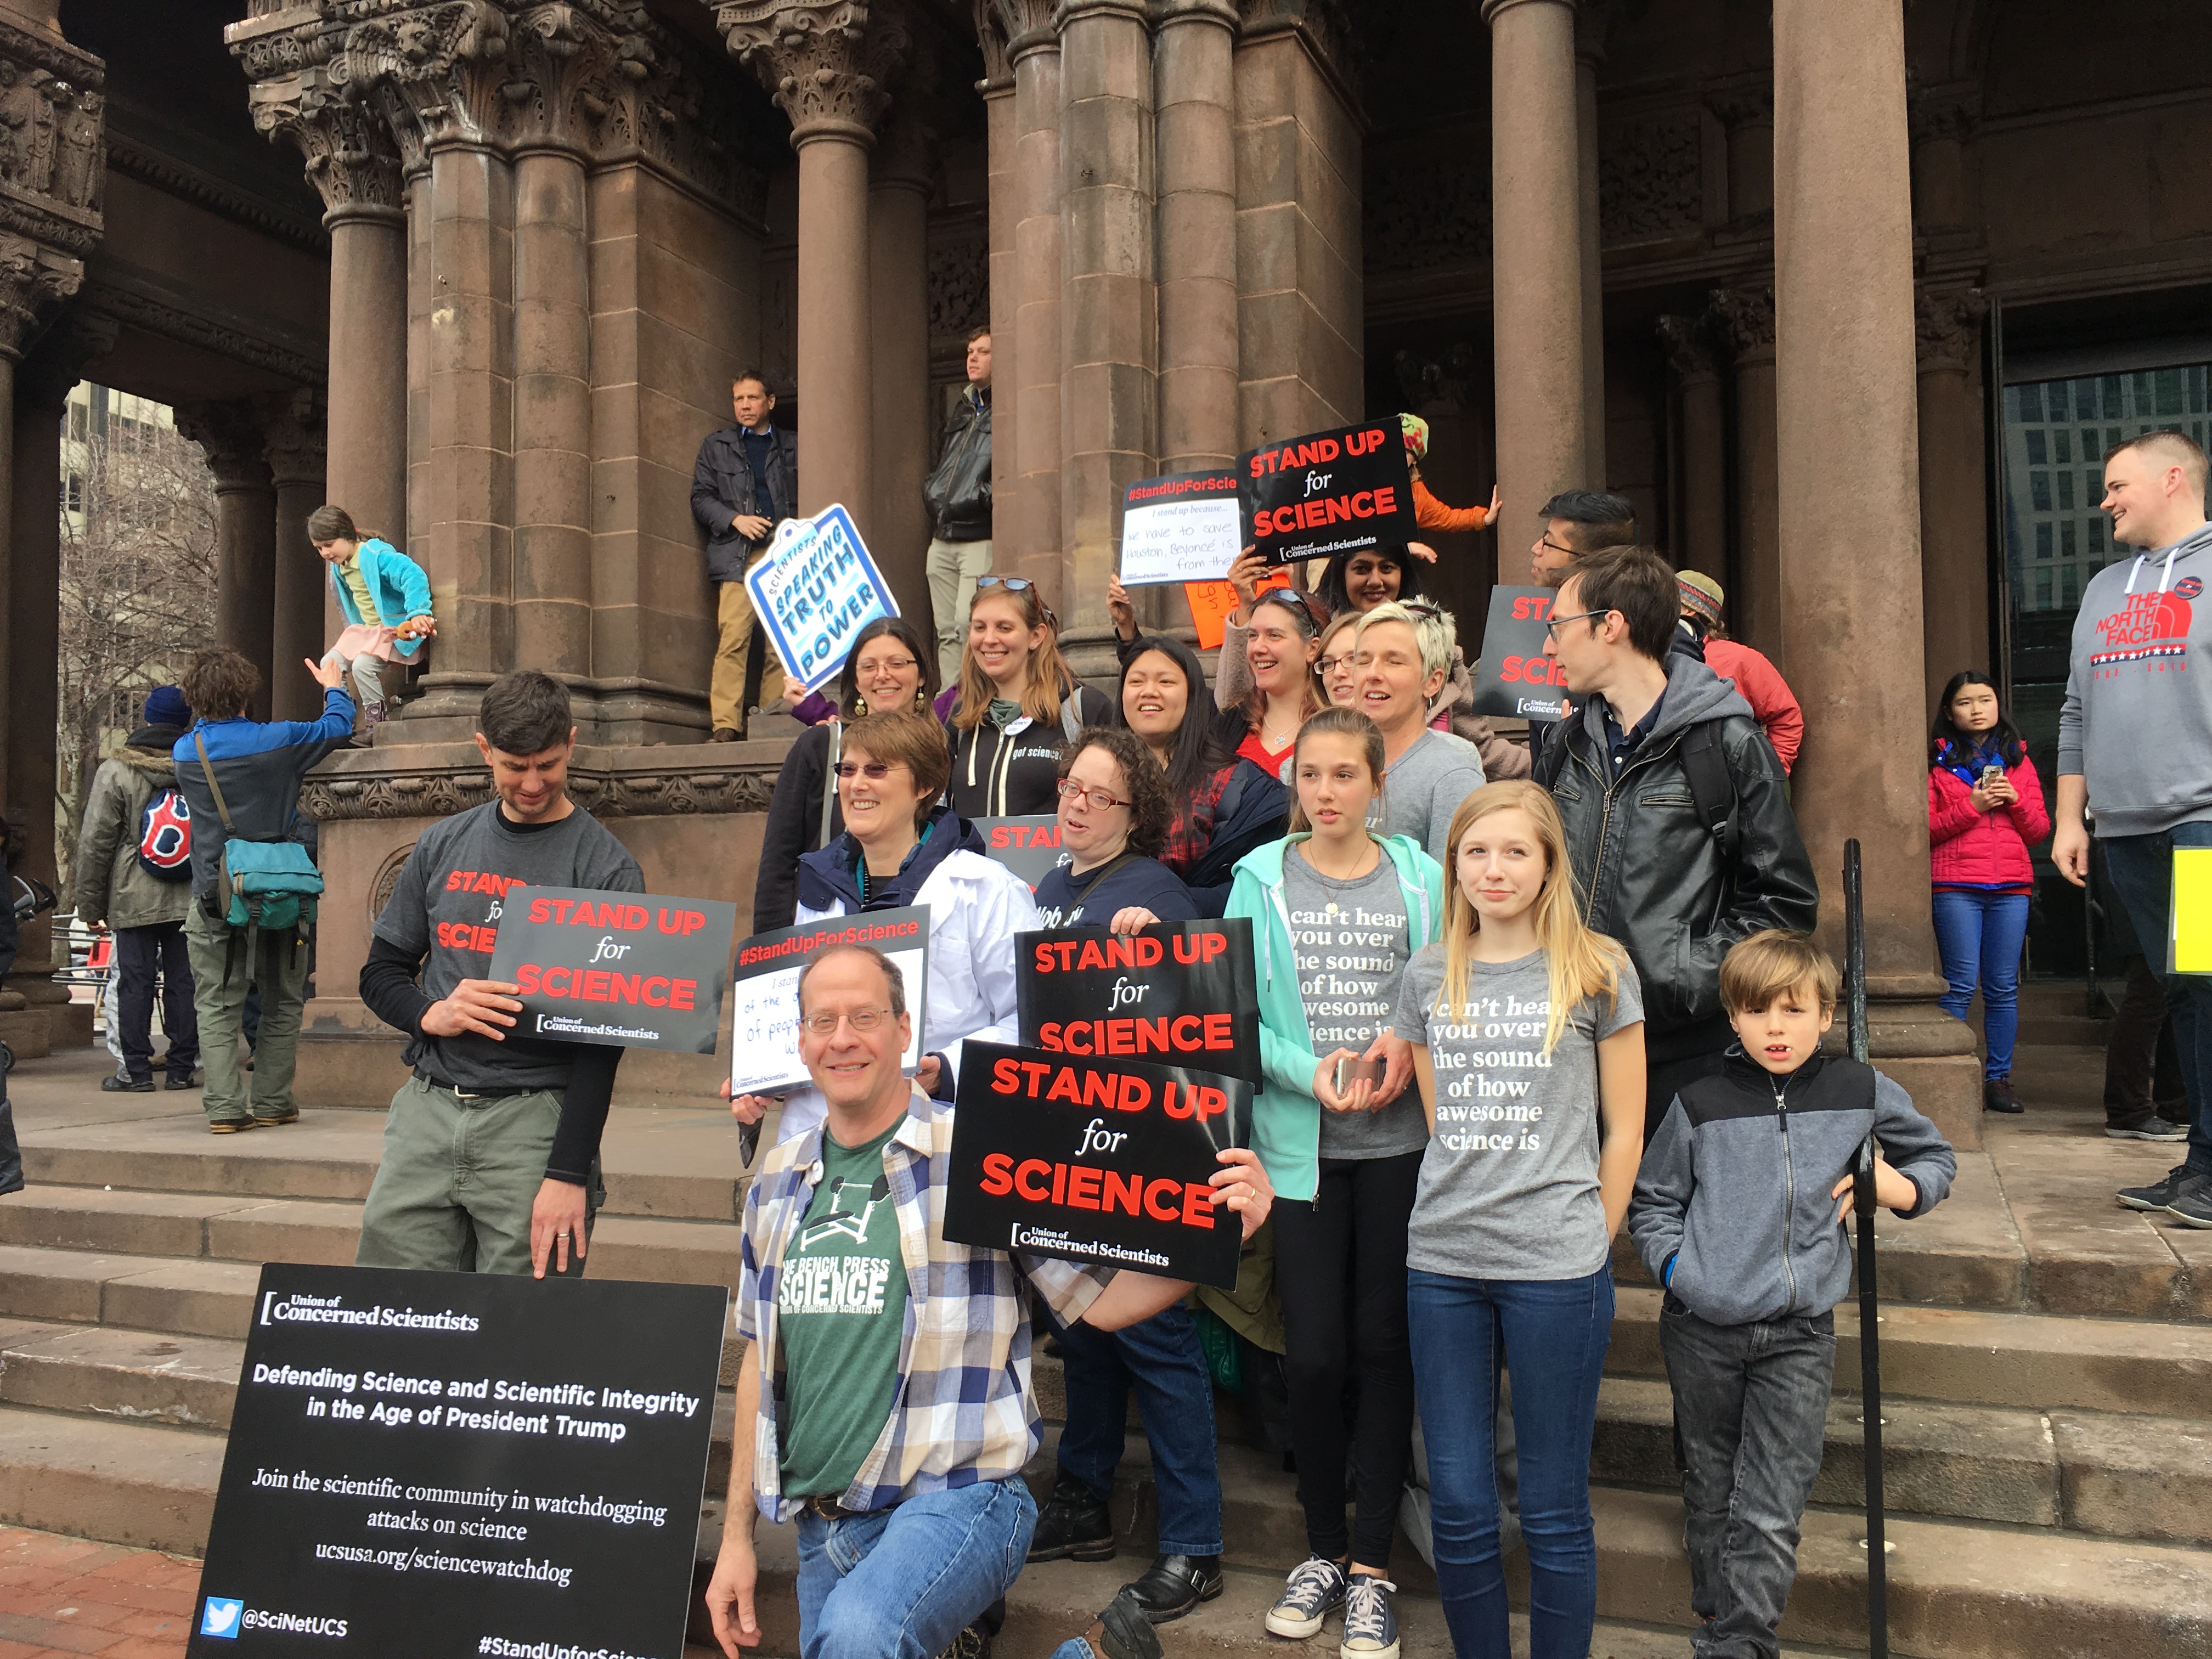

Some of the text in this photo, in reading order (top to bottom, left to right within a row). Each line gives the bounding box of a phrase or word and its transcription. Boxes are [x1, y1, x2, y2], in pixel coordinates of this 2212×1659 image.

[1250, 429, 1385, 478] STAND UP
[1128, 476, 1237, 501] #StandUpForScie
[1304, 470, 1332, 498] for
[1156, 506, 1177, 517] stand
[1179, 508, 1188, 516] up
[1190, 505, 1228, 514] because...
[1254, 486, 1397, 537] SCIENCE
[1128, 522, 1233, 541] we have to save
[1222, 539, 1233, 548] is
[1285, 535, 1376, 558] Concerned Scientists
[769, 535, 817, 596] SCIENTISTS
[776, 524, 842, 617] SPEAKING
[1177, 558, 1205, 570] from
[782, 542, 855, 636] TRUTH
[2126, 591, 2161, 611] THE
[819, 599, 833, 622] TO
[2095, 609, 2157, 635] NORTH
[800, 582, 875, 678] POWER
[2106, 625, 2152, 647] FACE
[1523, 702, 1574, 714] Concern
[1012, 746, 1027, 760] got
[446, 870, 527, 898] STAN
[527, 897, 707, 935] STAND UP
[1290, 907, 1406, 928] can't hear
[589, 935, 631, 963] for
[740, 920, 919, 966] #StandUpForScience
[1291, 930, 1394, 948] you over
[1035, 932, 1228, 973] STAND UP
[1325, 952, 1395, 972] sound
[516, 963, 698, 1011] SCIENCE
[1108, 976, 1150, 1011] for
[1301, 974, 1379, 995] of how
[744, 999, 755, 1013] of
[763, 995, 780, 1009] the
[1505, 995, 1562, 1017] hea
[543, 1020, 659, 1040] Concerned Scientists
[747, 1019, 761, 1042] of
[1039, 1013, 1234, 1056] SCIENCE
[1433, 1022, 1547, 1046] you over
[1433, 1045, 1553, 1069] the sound
[990, 1057, 1228, 1122] STAND UP
[1448, 1073, 1531, 1097] of how
[1436, 1105, 1543, 1121] awesome
[1074, 1118, 1128, 1156] for
[1440, 1127, 1540, 1150] science is
[979, 1152, 1218, 1229] SCIENCE
[1031, 1227, 1069, 1239] Union of
[1019, 1231, 1169, 1266] Concerned Scientists
[783, 1255, 890, 1274] WE BENCH PRESS
[291, 1294, 342, 1308] Union of
[778, 1271, 888, 1306] SCIENCE
[273, 1302, 479, 1331] Concerned Scientists
[839, 1304, 884, 1314] SCIENTISTS
[252, 1363, 700, 1418] Defending Science and Scientific Integrity
[306, 1396, 627, 1443] in the Age of President Trump
[251, 1468, 668, 1527] Join the scientific community in watchdogging
[367, 1510, 528, 1541] attacks on science
[315, 1543, 573, 1587] ucsusa.org/sciencewatchdog
[241, 1609, 348, 1638] @SciNetUCS
